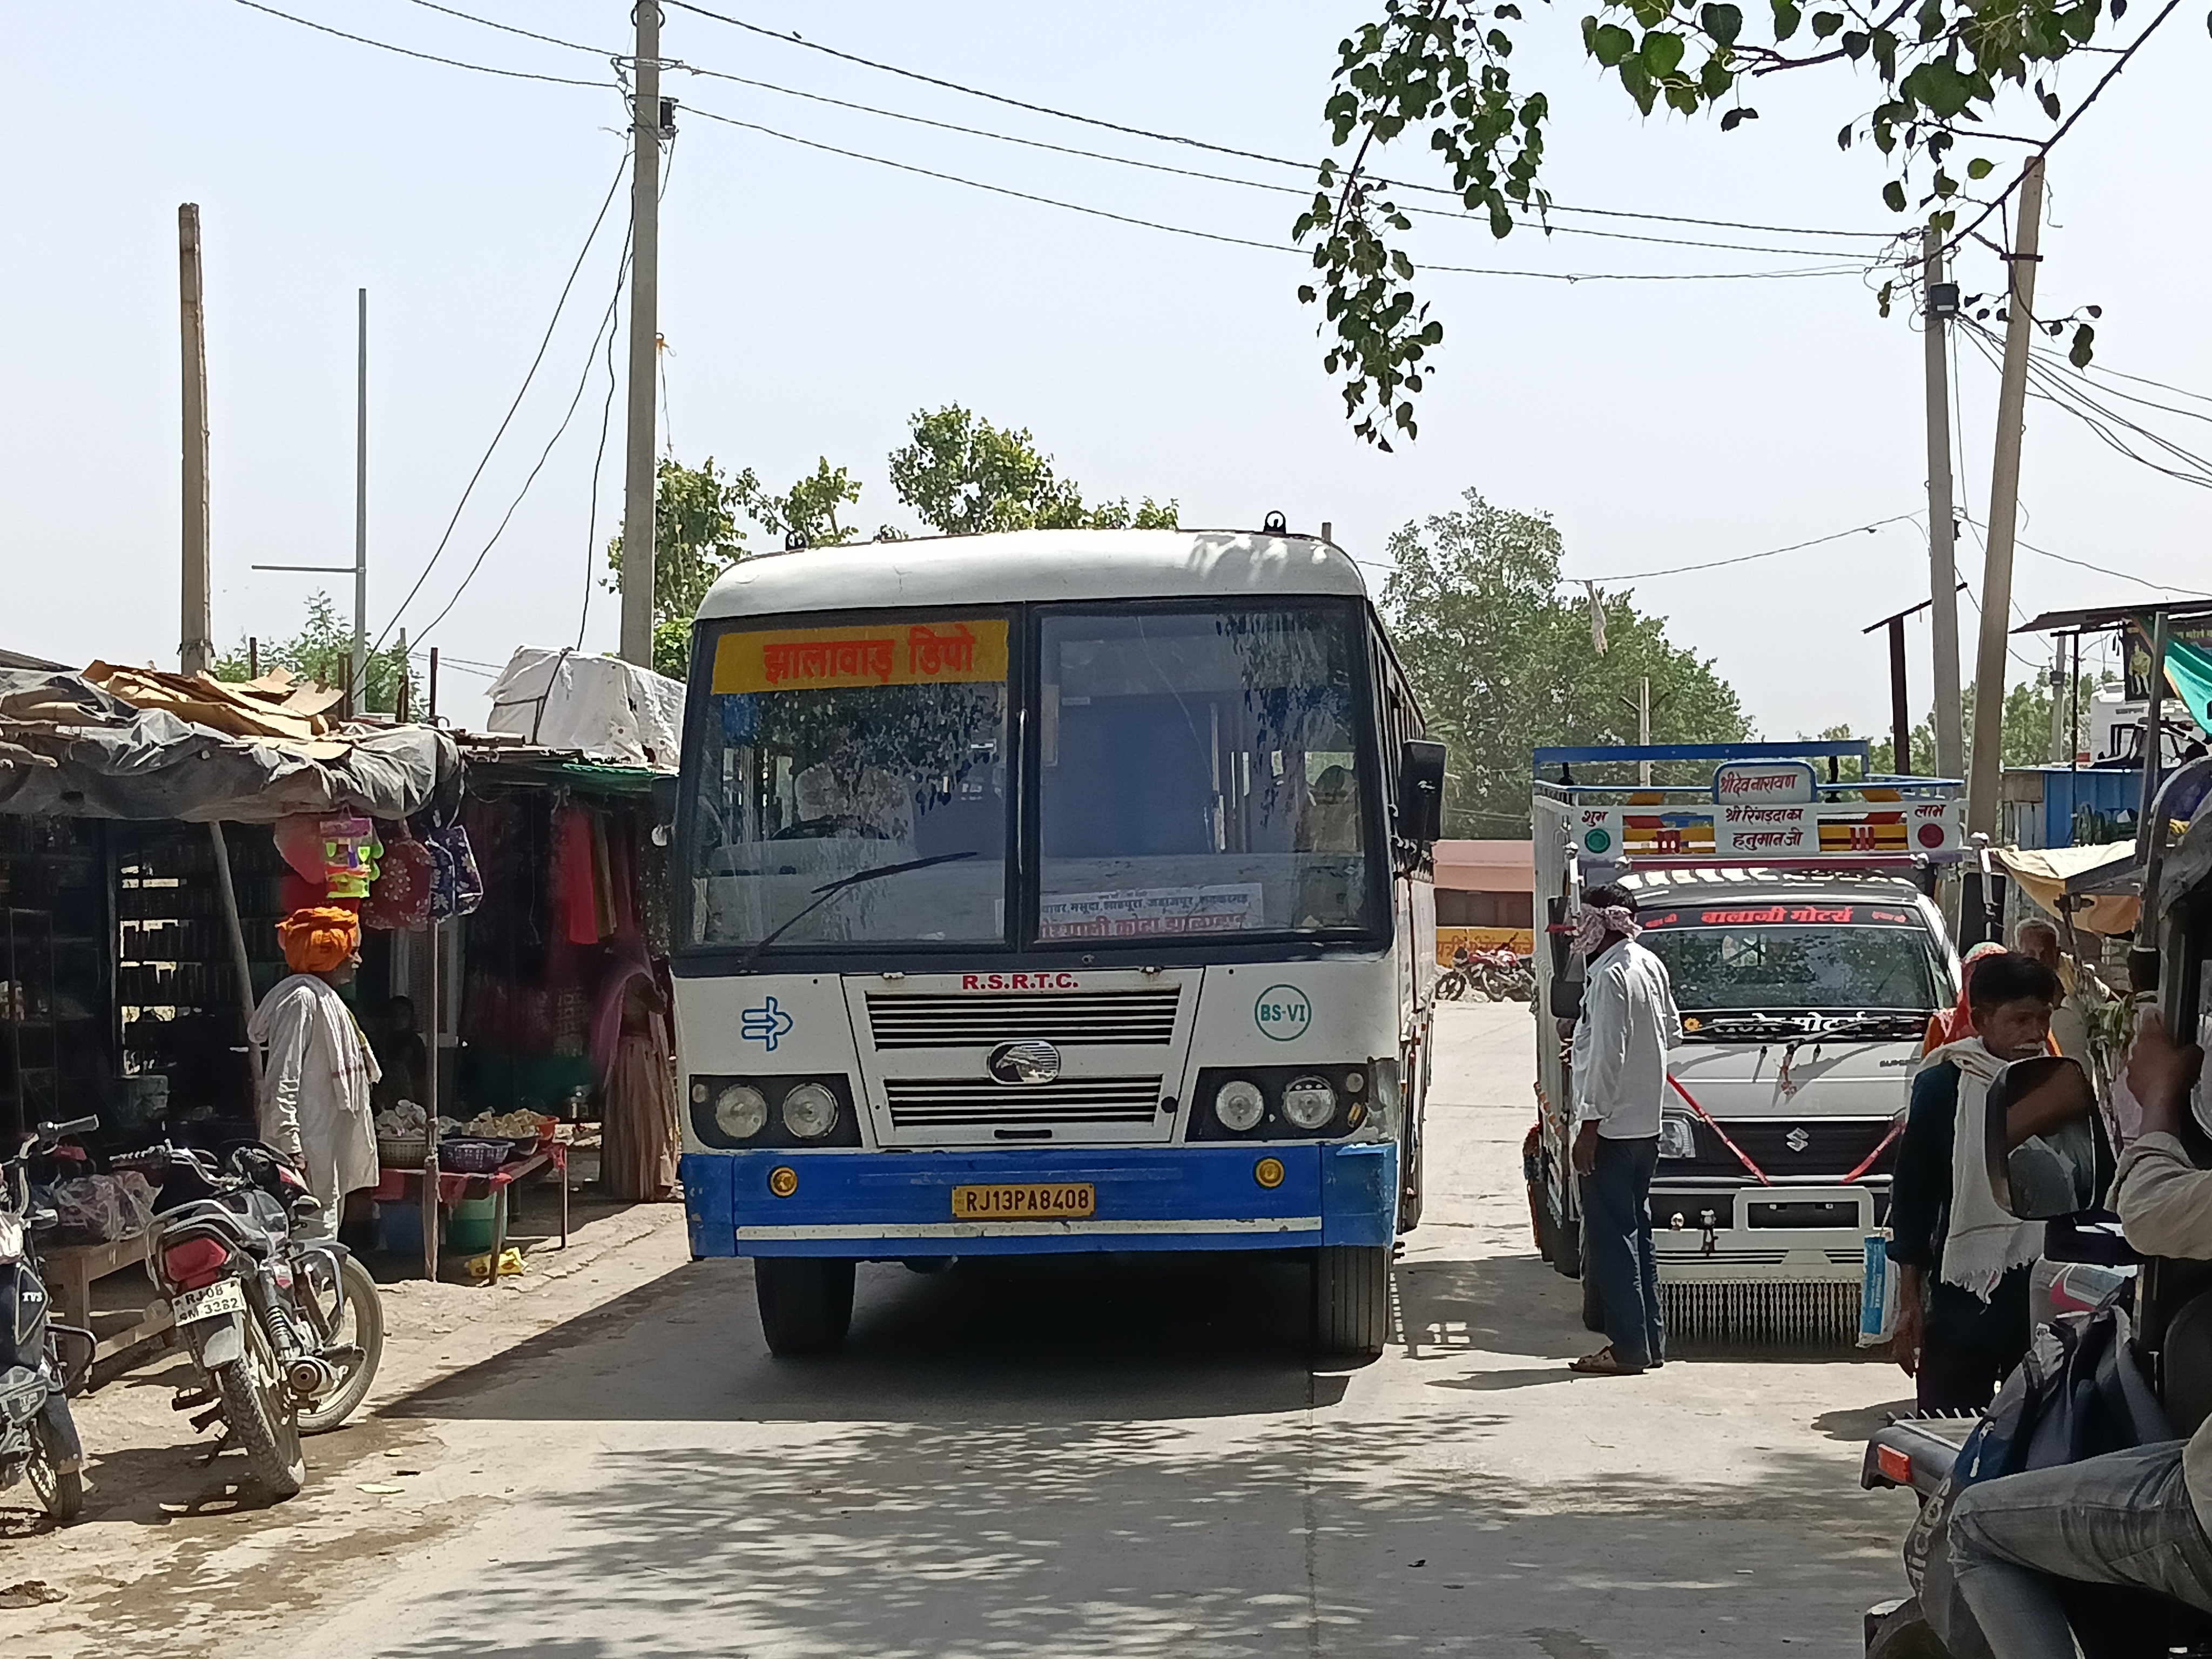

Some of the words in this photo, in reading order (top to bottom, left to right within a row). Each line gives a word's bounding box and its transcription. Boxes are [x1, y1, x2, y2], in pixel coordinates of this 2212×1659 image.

[908, 624, 975, 675] डिपो
[1581, 810, 1609, 827] शुभ
[1914, 804, 1946, 818] लाभ
[1701, 906, 1787, 923] बालाजी
[963, 974, 1078, 989] R.S.R.T.C.
[1260, 1004, 1305, 1022] BS-VI
[966, 1189, 1089, 1212] RJ13PA8408
[22, 1292, 43, 1302] TVS
